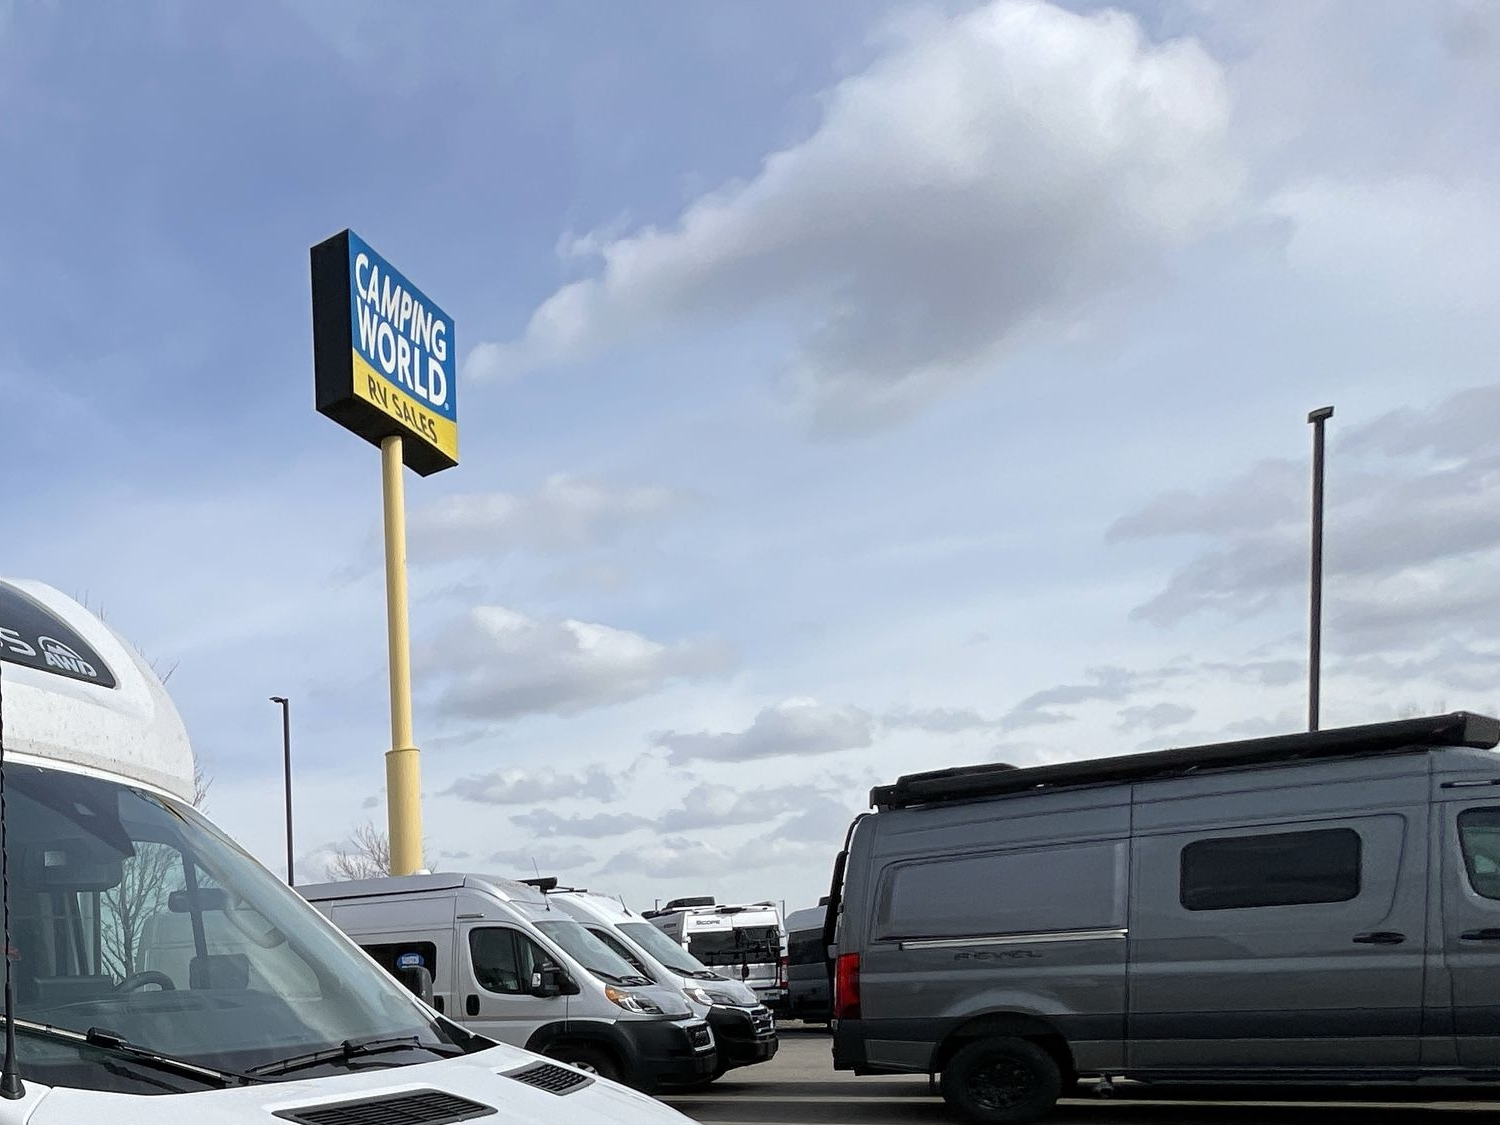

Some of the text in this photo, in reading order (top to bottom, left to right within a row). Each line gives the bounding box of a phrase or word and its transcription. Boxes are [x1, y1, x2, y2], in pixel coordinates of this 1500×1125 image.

[355, 252, 447, 361] CAMPING
[356, 295, 447, 406] WORLD
[368, 374, 437, 444] RV SALES
[44, 651, 97, 678] AWD
